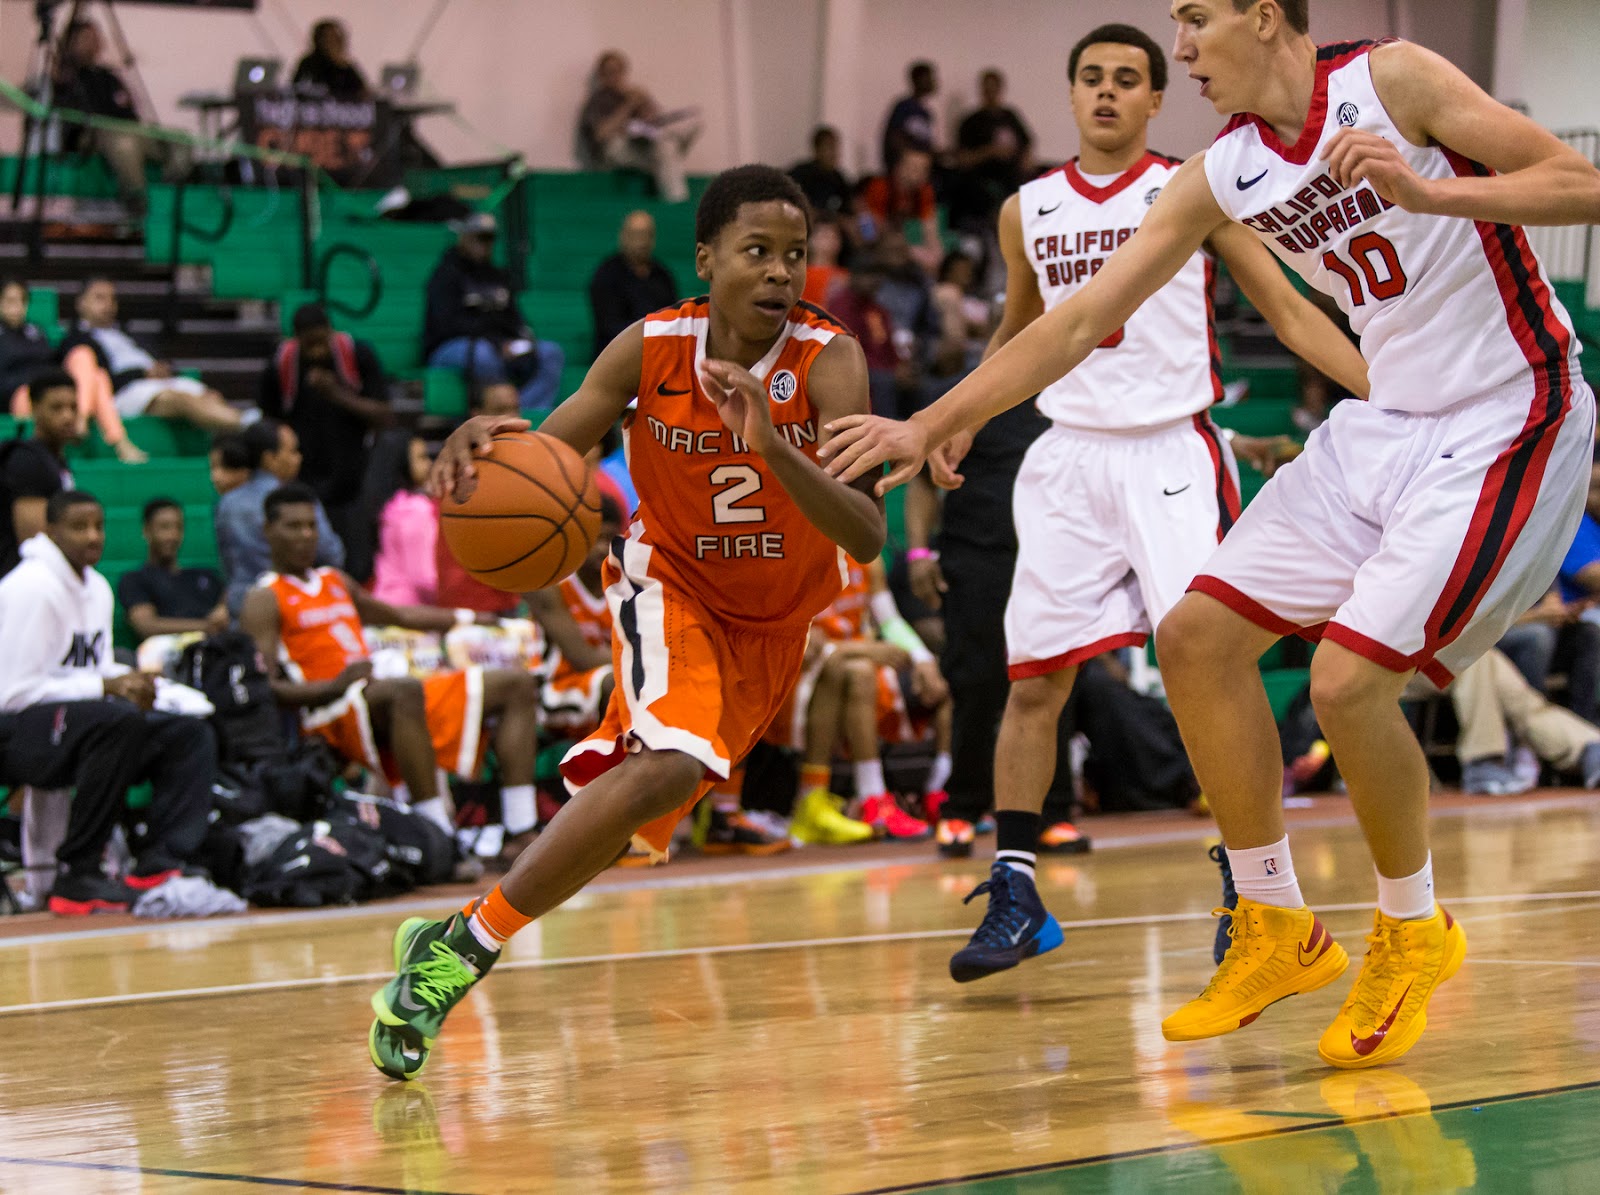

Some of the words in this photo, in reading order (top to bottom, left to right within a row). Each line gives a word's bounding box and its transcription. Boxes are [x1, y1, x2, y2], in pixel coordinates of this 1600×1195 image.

[1241, 171, 1347, 233] CALIFO
[1322, 231, 1408, 307] 10
[647, 414, 721, 454] MAC
[709, 464, 766, 525] 2
[696, 532, 785, 559] FIRE
